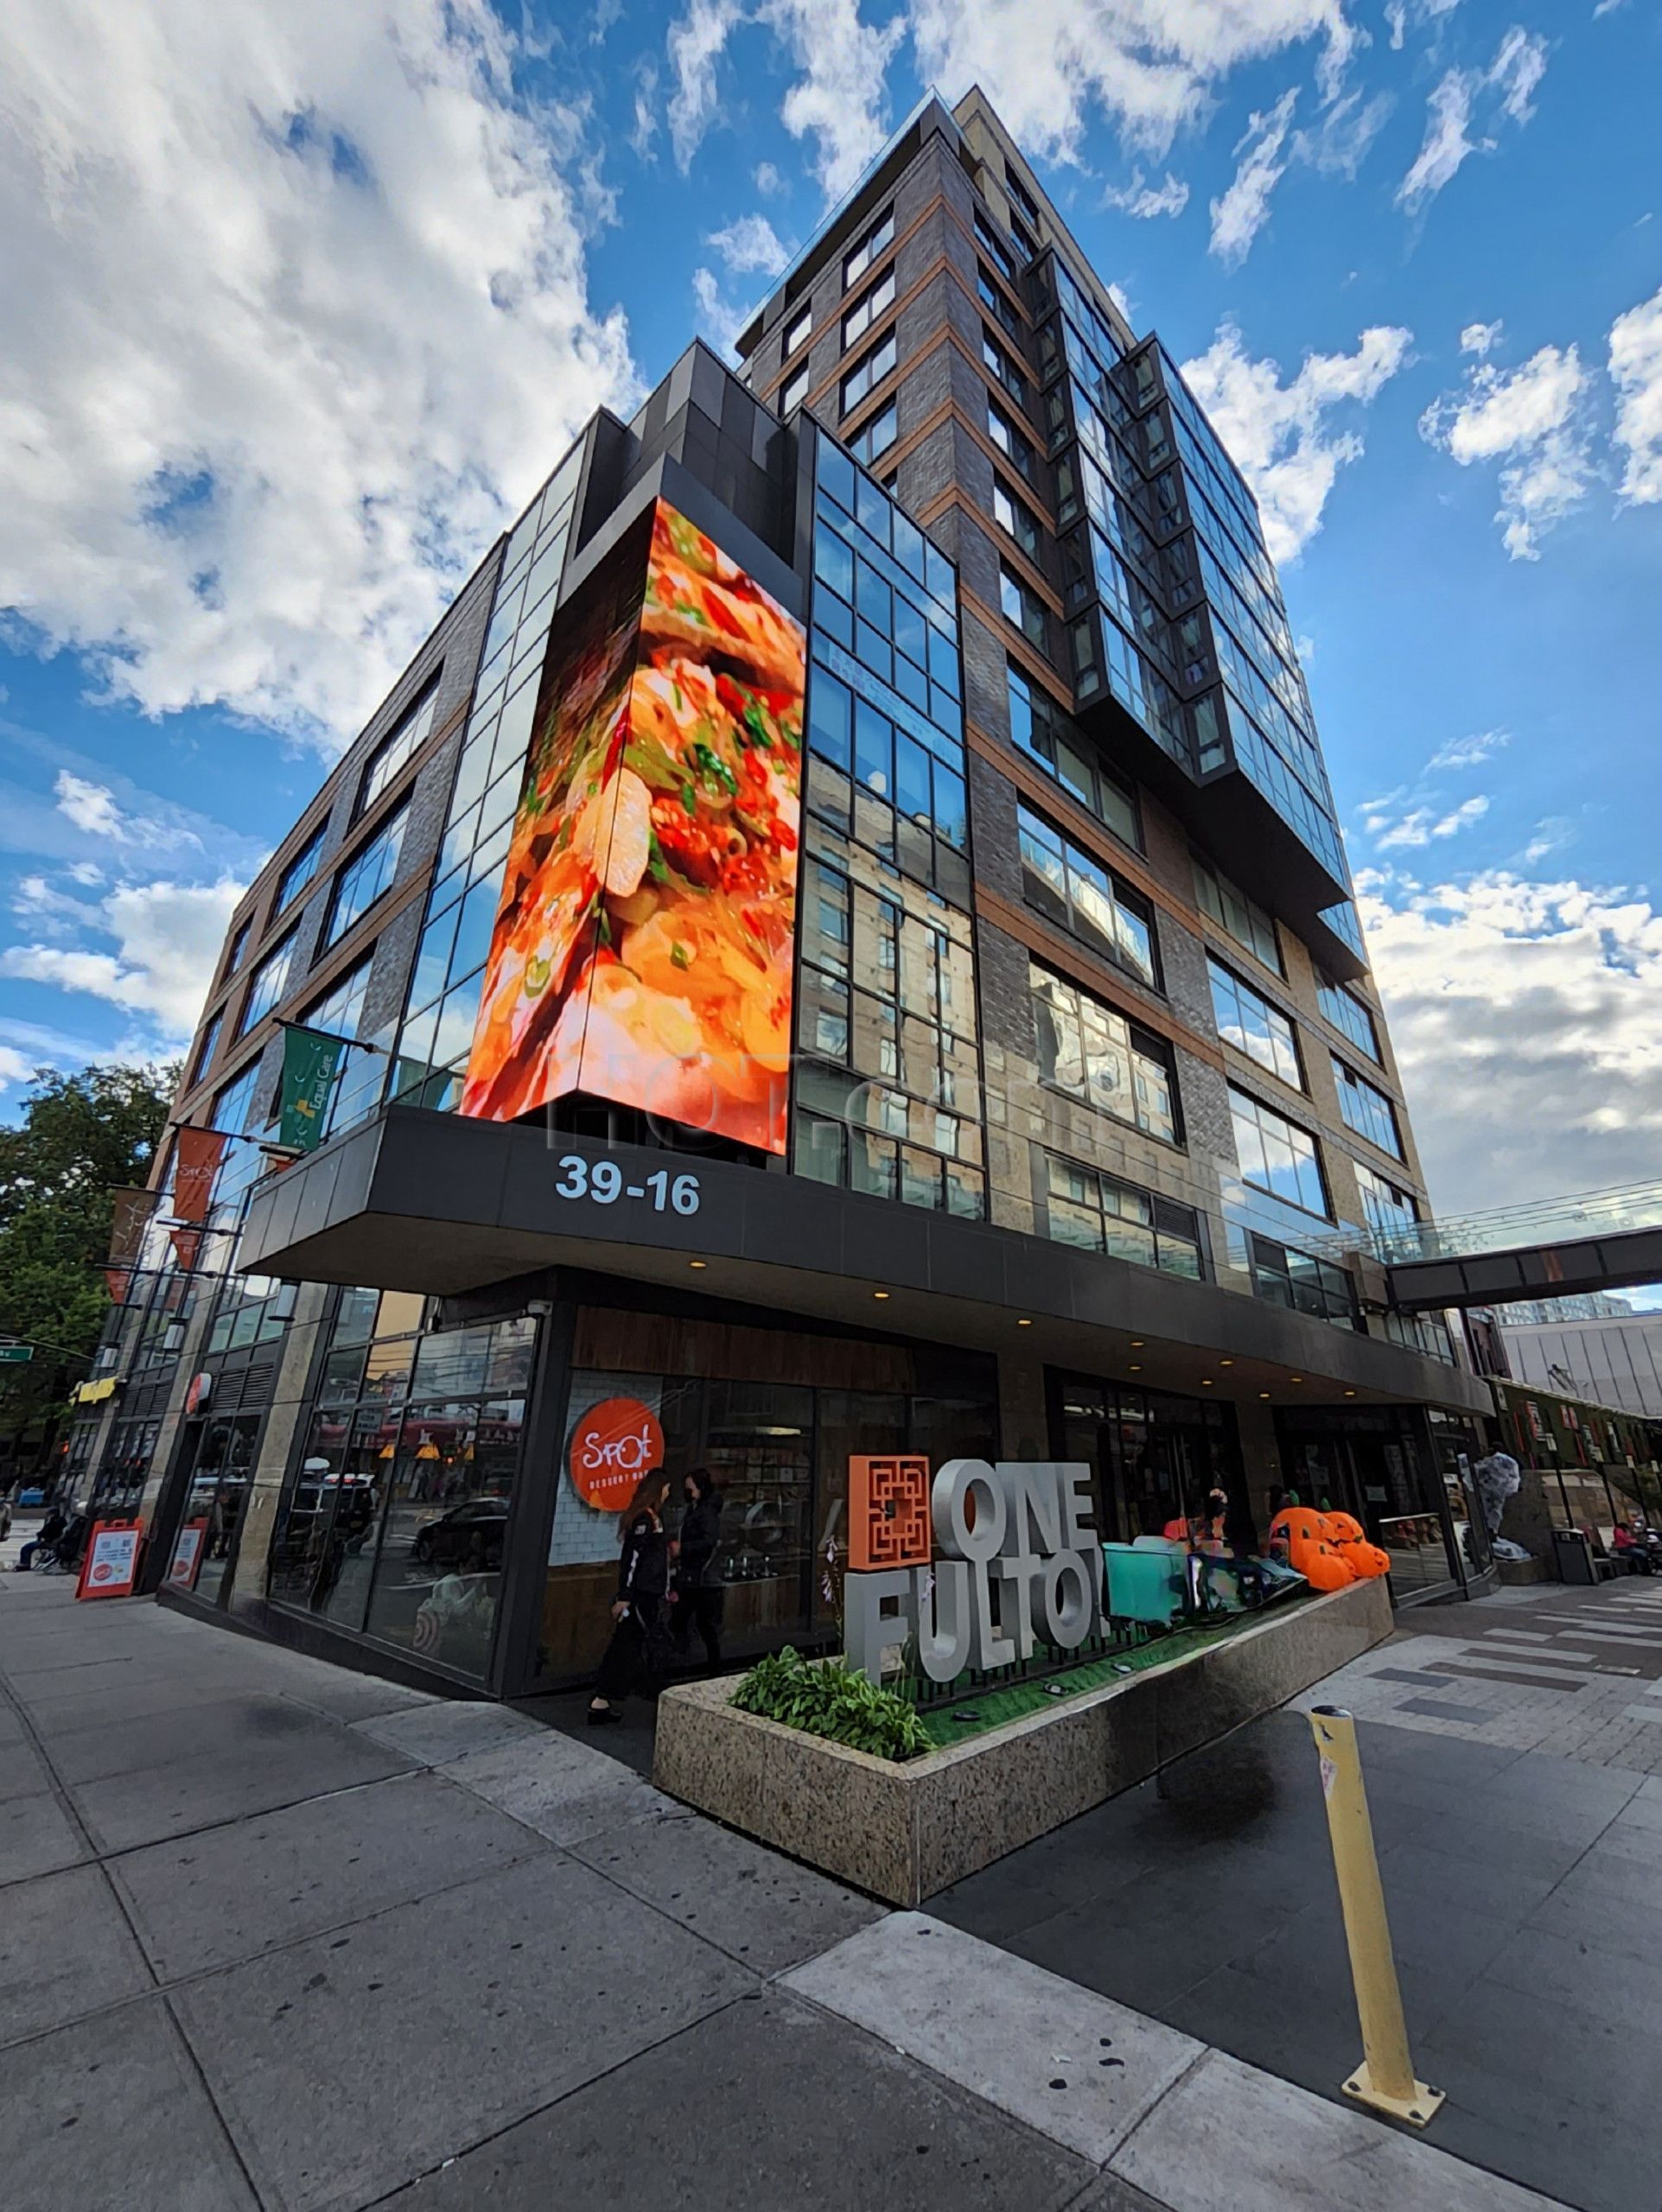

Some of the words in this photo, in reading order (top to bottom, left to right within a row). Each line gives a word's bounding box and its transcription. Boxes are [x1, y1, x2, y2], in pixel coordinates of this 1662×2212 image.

[317, 1054, 334, 1078] Care
[309, 1079, 328, 1109] Equal
[555, 1155, 701, 1217] 39-16
[589, 1474, 629, 1490] DESSERT
[932, 1459, 1098, 1562] ONE
